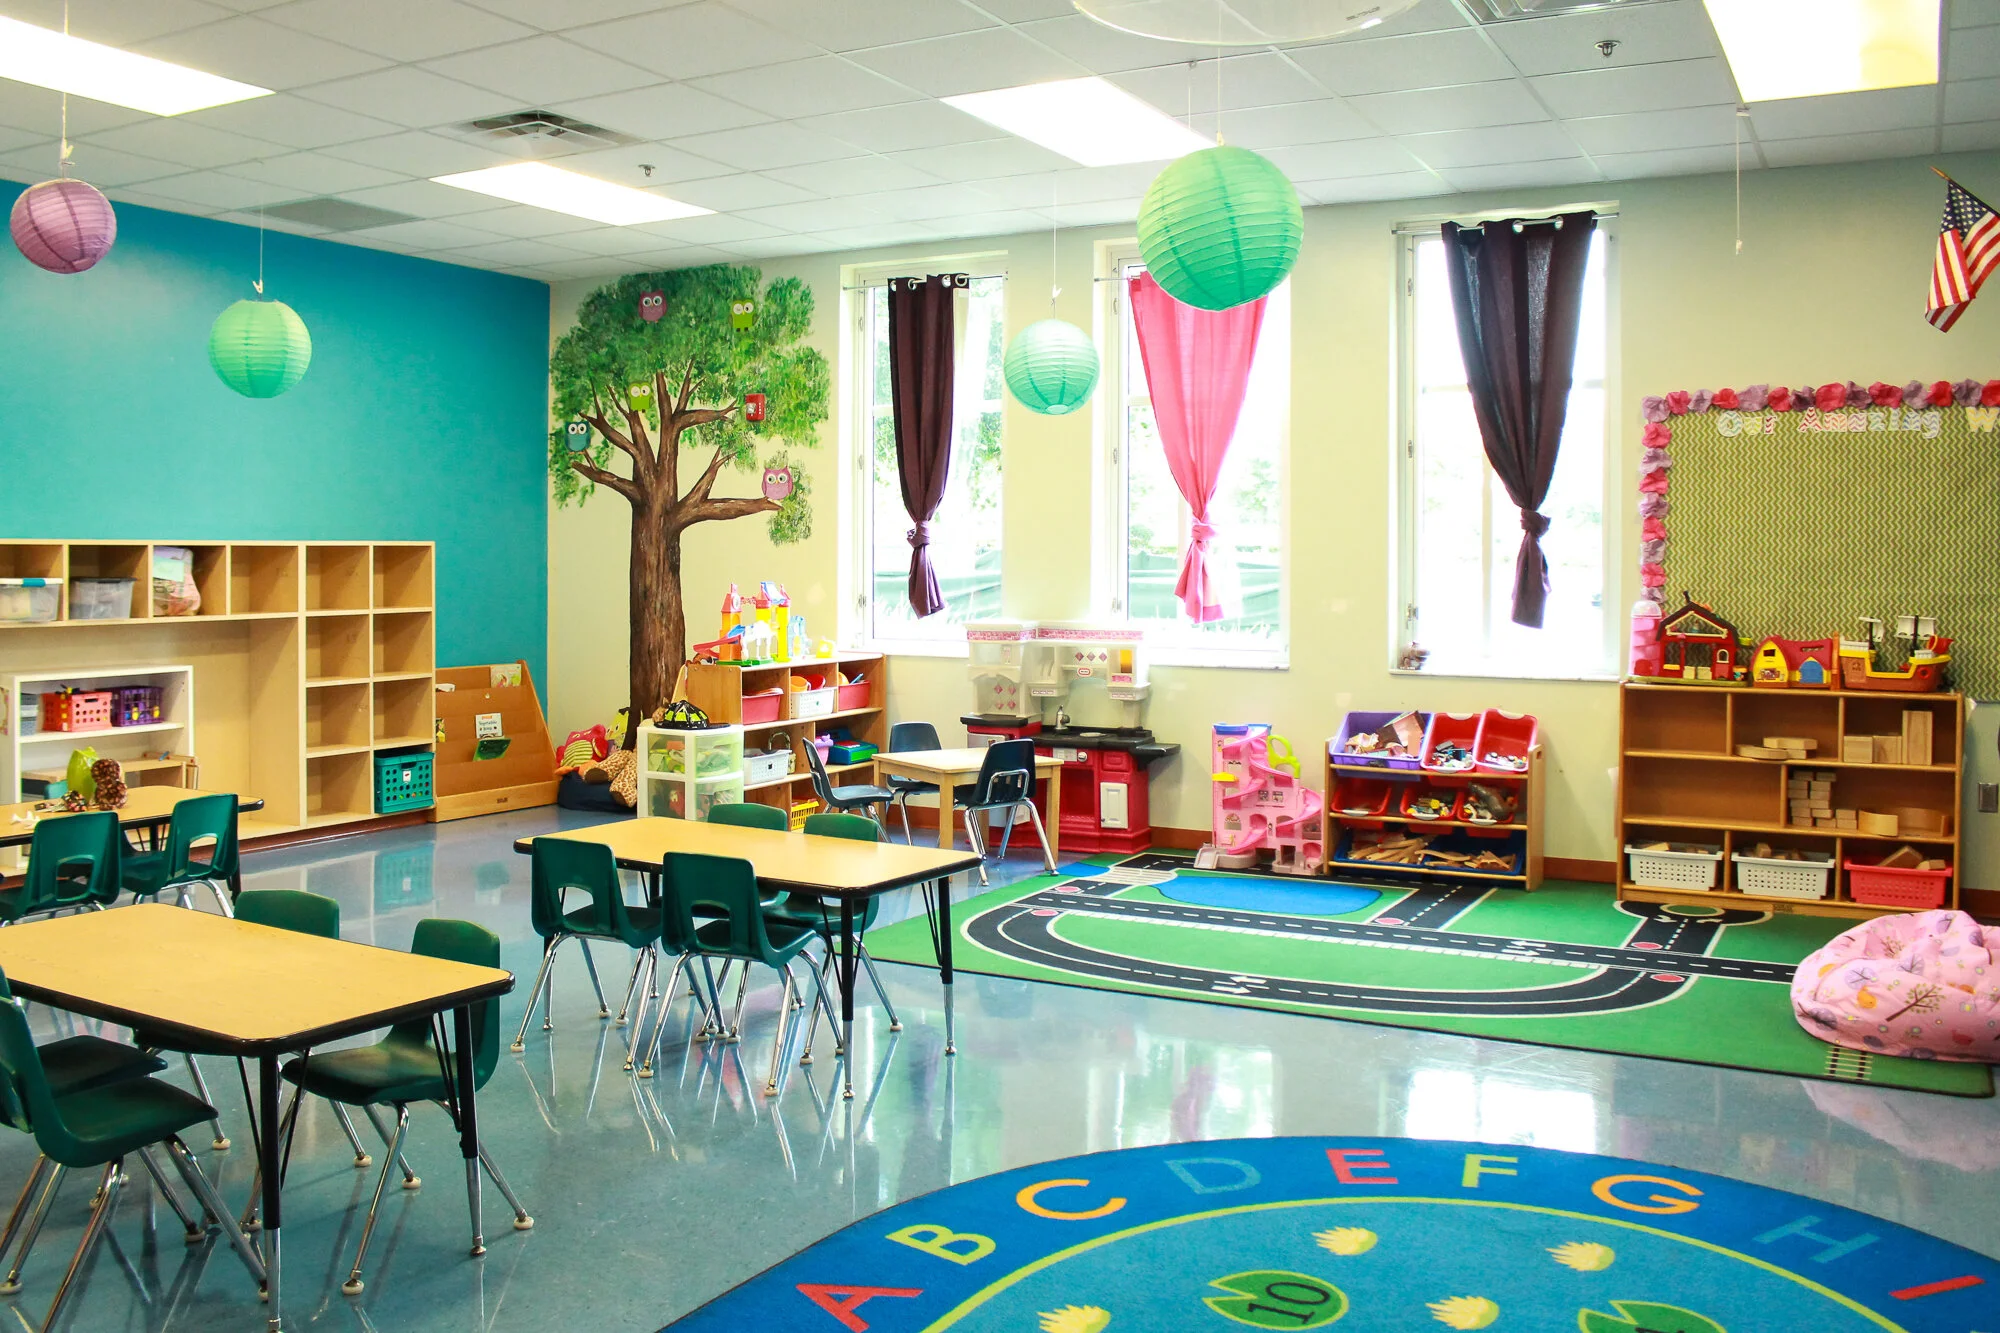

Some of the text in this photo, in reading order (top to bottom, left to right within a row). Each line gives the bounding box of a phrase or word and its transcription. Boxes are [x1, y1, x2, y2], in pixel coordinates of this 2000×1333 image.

[1717, 411, 1777, 437] Our
[1798, 406, 1940, 439] Amazing
[796, 1149, 1985, 1333] A B C D E F G H I
[1248, 1282, 1330, 1324] 10
